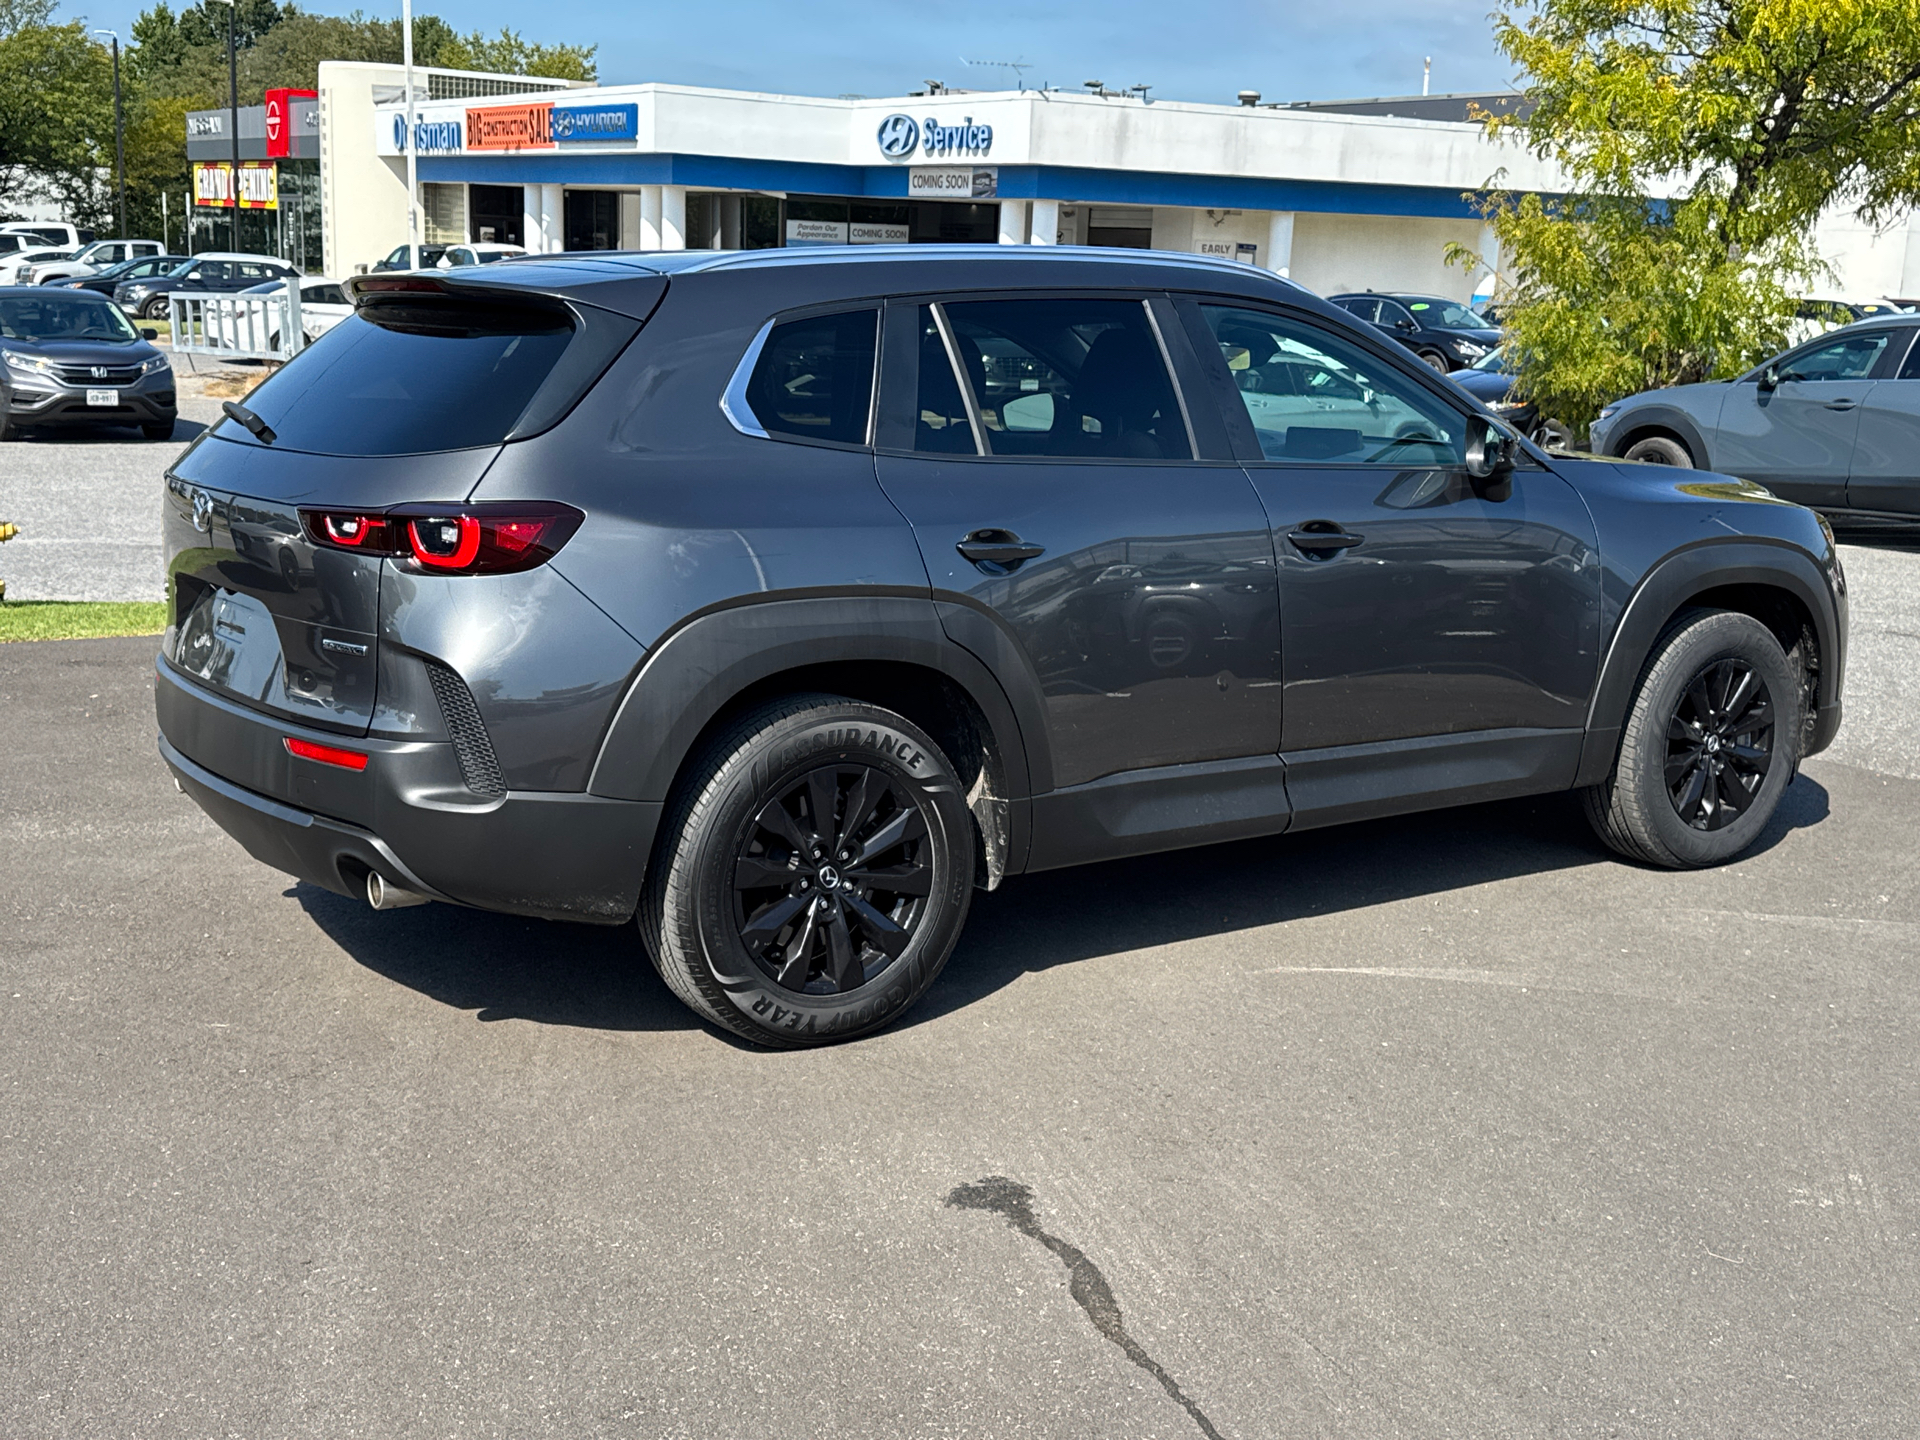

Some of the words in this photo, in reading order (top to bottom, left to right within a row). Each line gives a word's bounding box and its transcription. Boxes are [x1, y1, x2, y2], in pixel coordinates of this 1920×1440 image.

[188, 116, 222, 134] NISSAN
[393, 113, 462, 151] Ouisman
[467, 112, 482, 146] BIG
[483, 119, 528, 137] CONSTRUCTION
[529, 108, 554, 145] SALE
[576, 112, 627, 132] HYUNDAI
[922, 116, 993, 151] Service
[197, 168, 228, 200] GRAND
[912, 174, 943, 189] COMING
[945, 174, 969, 189] SOON
[796, 230, 839, 240] Appearance
[797, 223, 823, 232] Pardon
[852, 228, 882, 238] COMING
[885, 229, 907, 239] SOON
[1201, 243, 1231, 254] EARLY
[780, 727, 926, 770] ASSURANCE
[751, 986, 905, 1035] GOODYEAR
